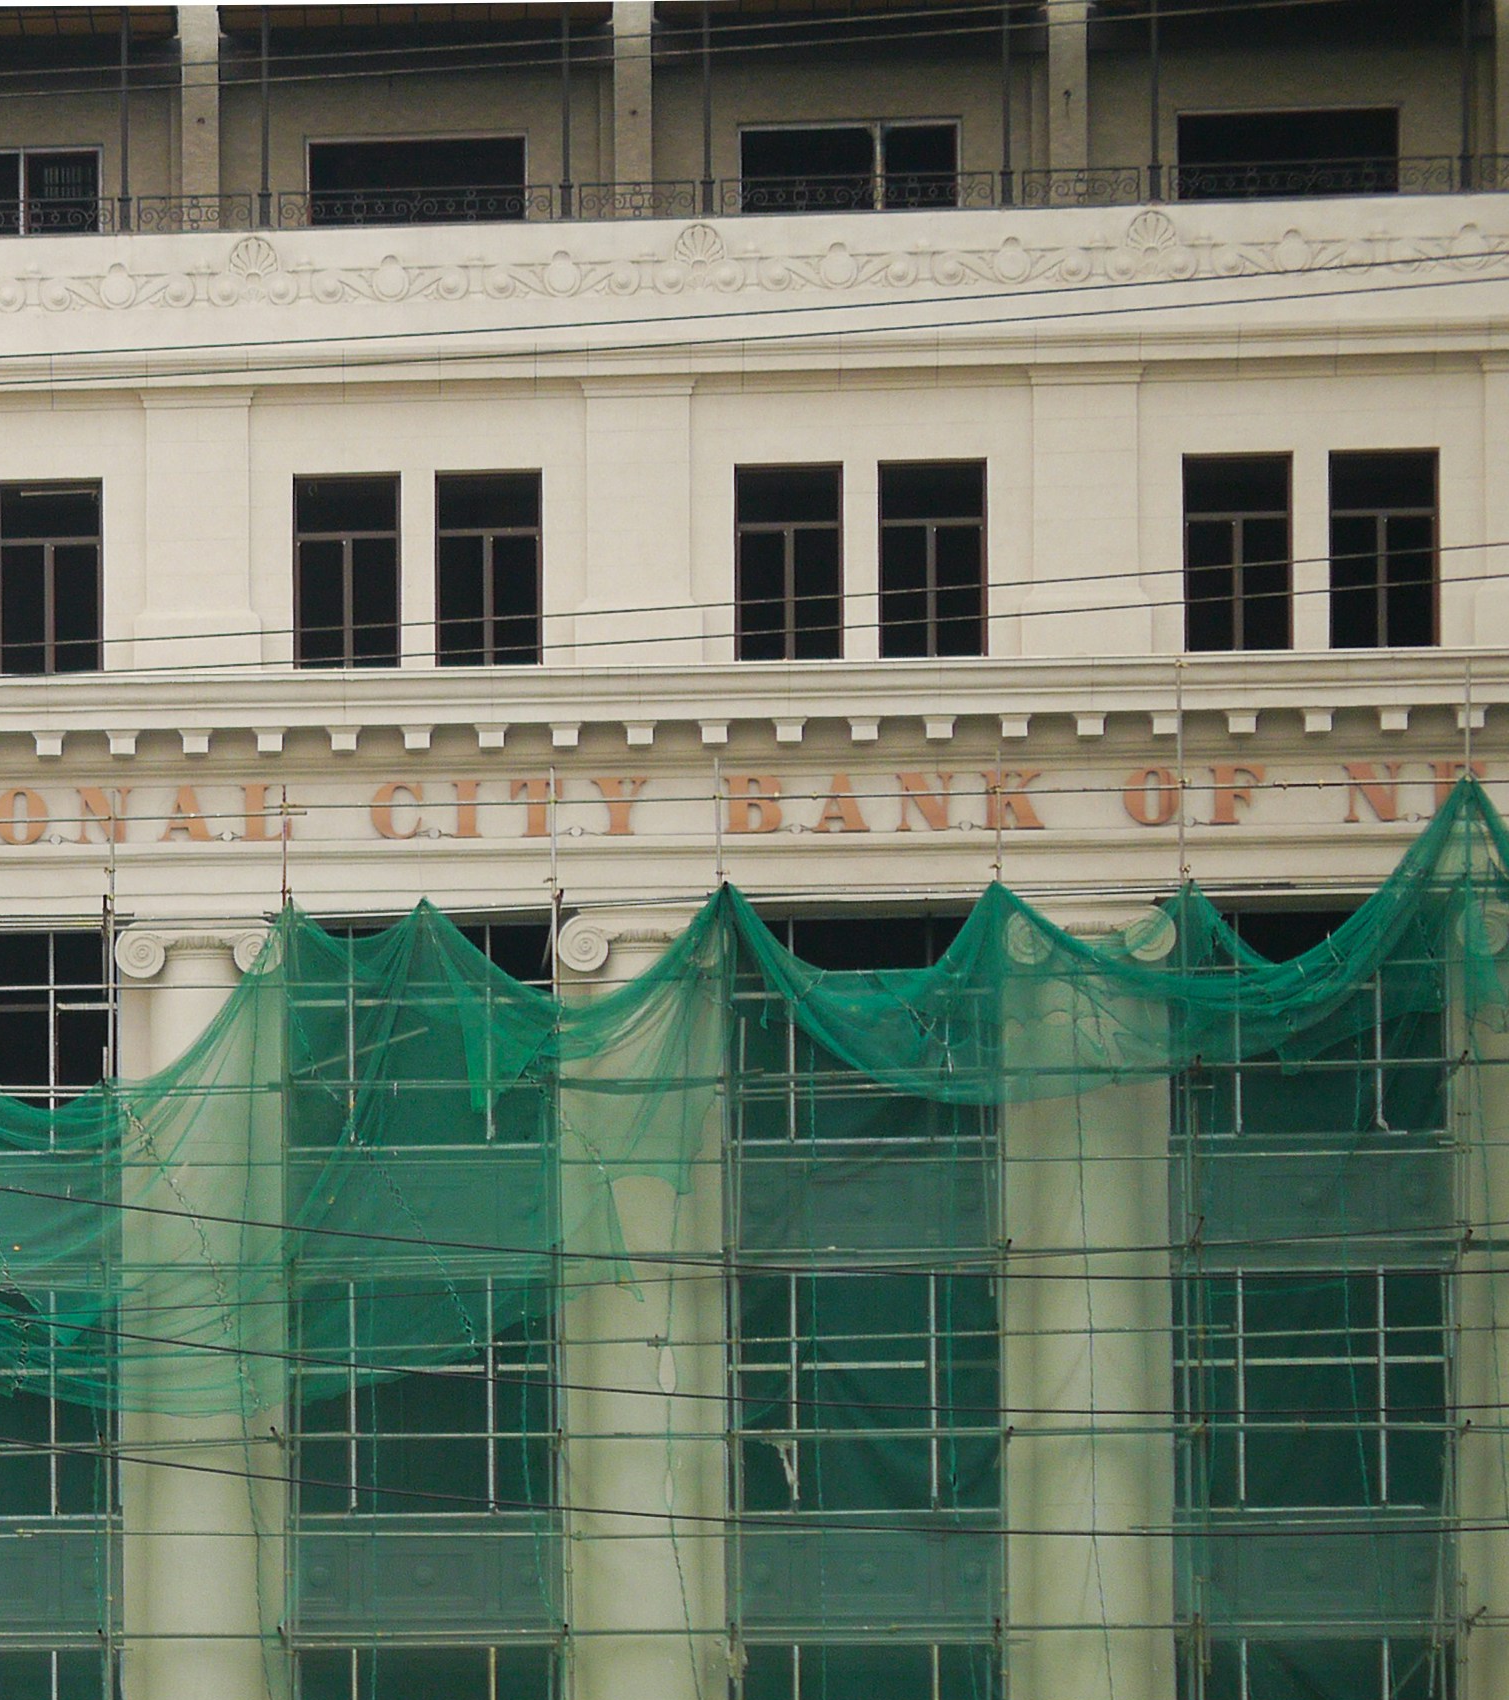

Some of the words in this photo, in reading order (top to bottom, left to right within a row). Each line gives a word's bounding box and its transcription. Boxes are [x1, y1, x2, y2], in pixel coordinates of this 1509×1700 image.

[369, 774, 650, 840] CITY
[724, 767, 1045, 835] BANK
[1123, 762, 1269, 825] OF
